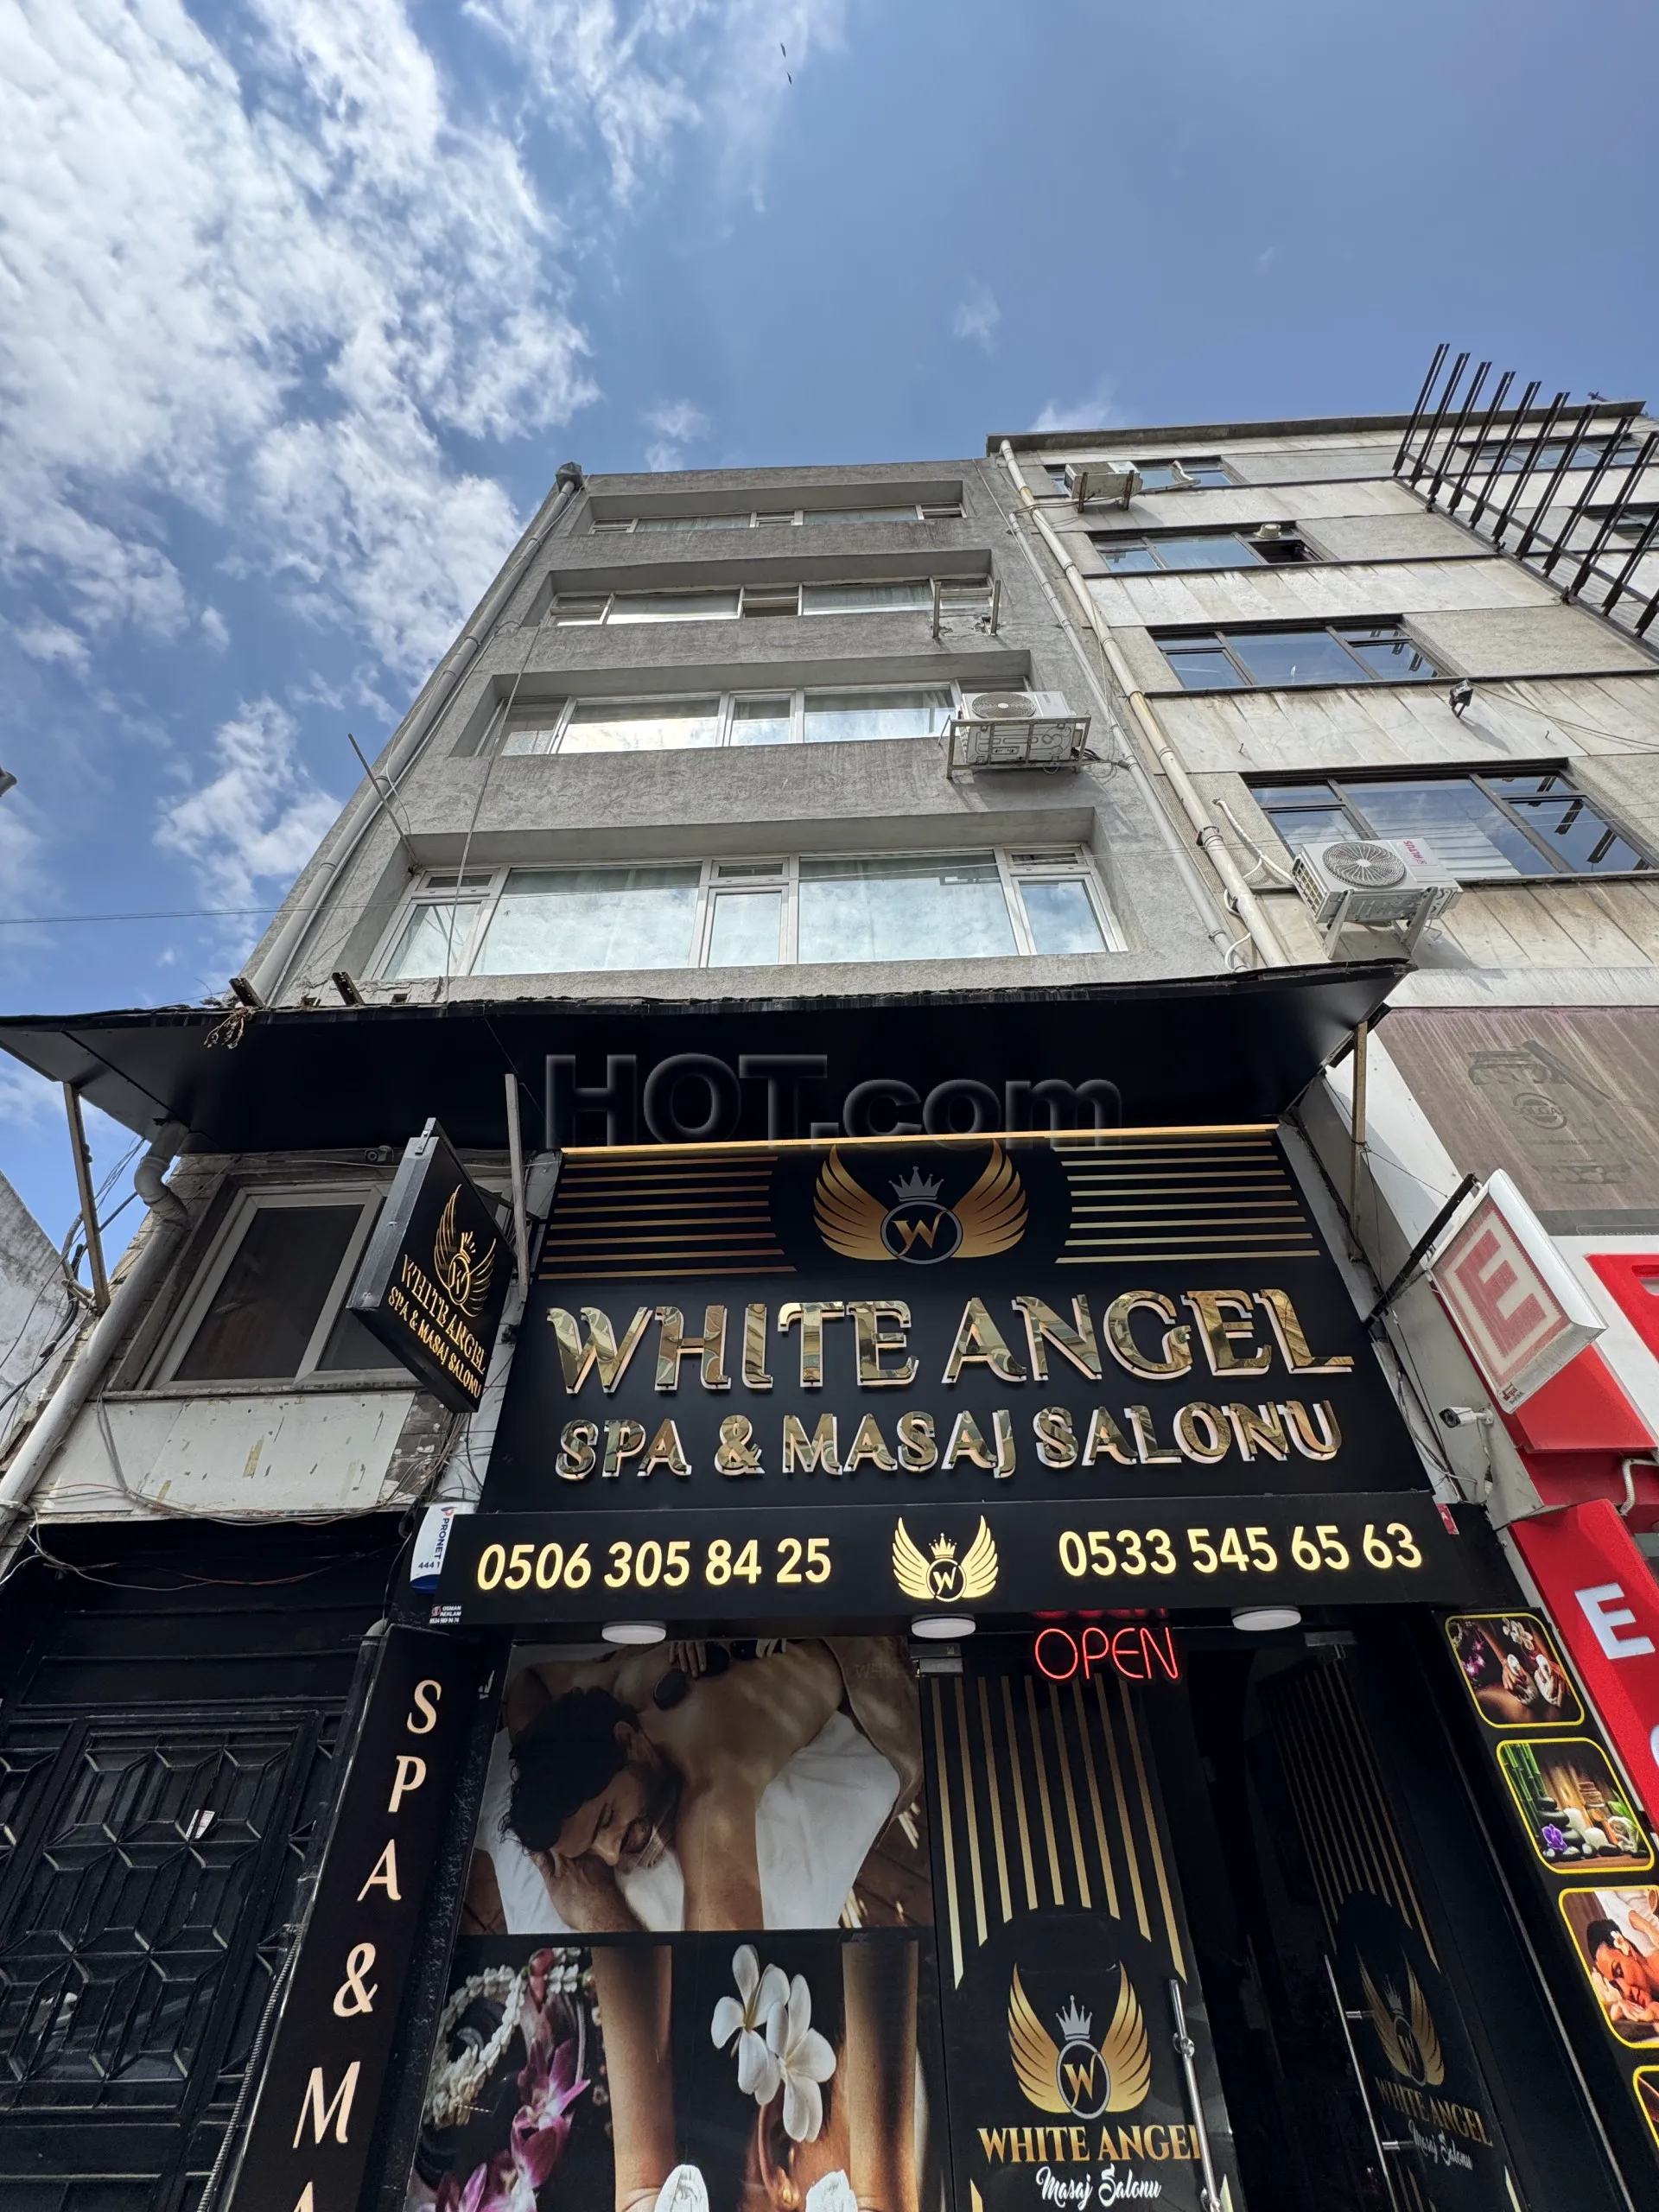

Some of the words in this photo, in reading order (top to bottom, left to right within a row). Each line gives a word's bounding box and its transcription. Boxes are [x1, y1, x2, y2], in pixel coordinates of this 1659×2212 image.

[891, 1210, 948, 1256] W
[401, 1254, 449, 1327] WHITE
[445, 1314, 486, 1374] ANGEL
[1454, 1228, 1547, 1358] E
[389, 1286, 410, 1322] SPA
[409, 1309, 419, 1332] &
[417, 1319, 450, 1365] MASAJ
[448, 1352, 482, 1398] SALONU
[546, 1300, 920, 1395] WHITE
[942, 1288, 1356, 1383] ANGEL
[556, 1414, 691, 1480] SPA
[714, 1414, 765, 1476] &
[781, 1408, 1013, 1478] MASAJ
[1033, 1400, 1344, 1468] SALONU
[434, 1518, 449, 1559] PRONET
[477, 1542, 591, 1591] 0506
[604, 1541, 690, 1587] 305
[705, 1539, 761, 1586] 84
[777, 1538, 831, 1584] 25
[1058, 1529, 1177, 1578] 0533
[1186, 1526, 1277, 1573] 545
[1291, 1524, 1351, 1572] 65
[1363, 1522, 1423, 1569] 63
[932, 1566, 957, 1595] W
[1033, 1626, 1180, 1681] OPEN
[358, 1679, 442, 1902] SPA
[333, 1942, 378, 2017] &
[1062, 2052, 1097, 2108] W
[1373, 2075, 1431, 2123] WHITE
[1428, 2094, 1494, 2147] ANGEL
[977, 2126, 1090, 2164] WHITE
[1036, 2166, 1092, 2211] Masaj
[1098, 2162, 1161, 2207] Salonu
